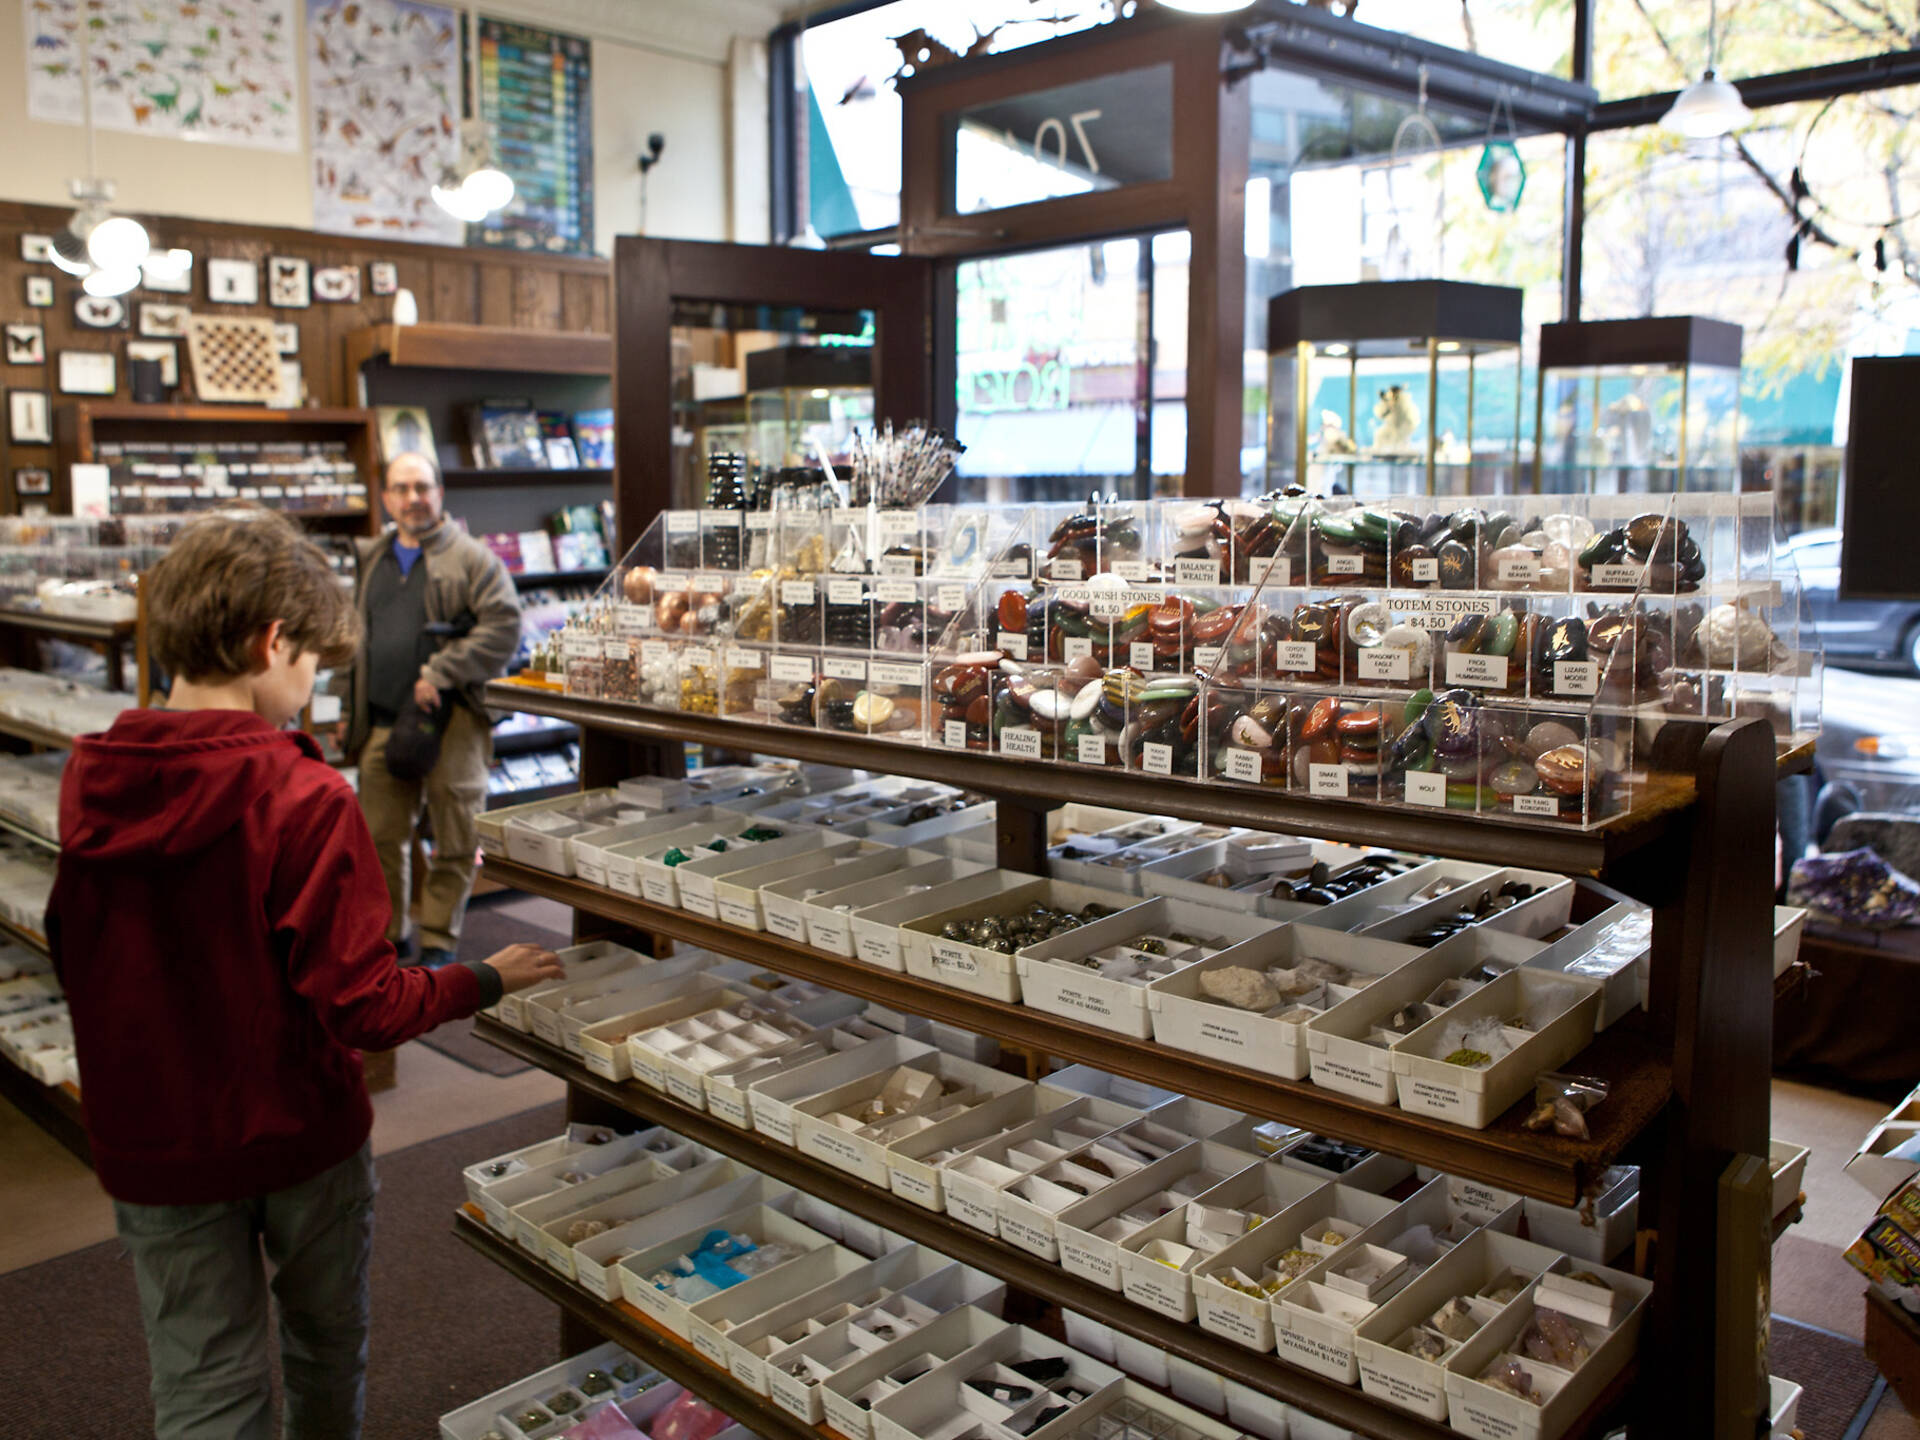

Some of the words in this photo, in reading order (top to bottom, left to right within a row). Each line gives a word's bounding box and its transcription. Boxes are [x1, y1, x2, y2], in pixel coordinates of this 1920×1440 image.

[1180, 563, 1215, 572] BALANCE
[1182, 572, 1214, 582] WEALTH
[1062, 589, 1090, 600] GOOD
[1092, 590, 1118, 600] WISH
[1121, 591, 1161, 602] STONES
[1094, 604, 1120, 614] $4.50
[1386, 600, 1431, 611] TOTEM
[1435, 600, 1490, 612] STONES
[1410, 616, 1446, 629] $4.50
[1466, 666, 1487, 674] HORSE
[1455, 674, 1498, 682] HUMMINGBIRD
[1004, 732, 1037, 744] HEALING
[1006, 742, 1036, 753] HEALTH
[940, 948, 962, 960] PYRITE
[1062, 989, 1082, 998] PYRITE
[1085, 1003, 1111, 1016] MARKED
[1464, 1184, 1495, 1202] SPINEL
[1026, 1224, 1057, 1244] CRYSTALS
[1064, 1244, 1080, 1256] RUBY
[1080, 1248, 1112, 1269] CRYSTALS
[1068, 1254, 1084, 1266] INDIA
[1280, 1328, 1306, 1344] SPINEL
[1307, 1339, 1316, 1347] IN
[1318, 1341, 1349, 1360] QUARTZ
[1282, 1338, 1320, 1357] MYANMAR
[1470, 1416, 1490, 1428] SOUTH
[1492, 1423, 1512, 1437] AFRICA
